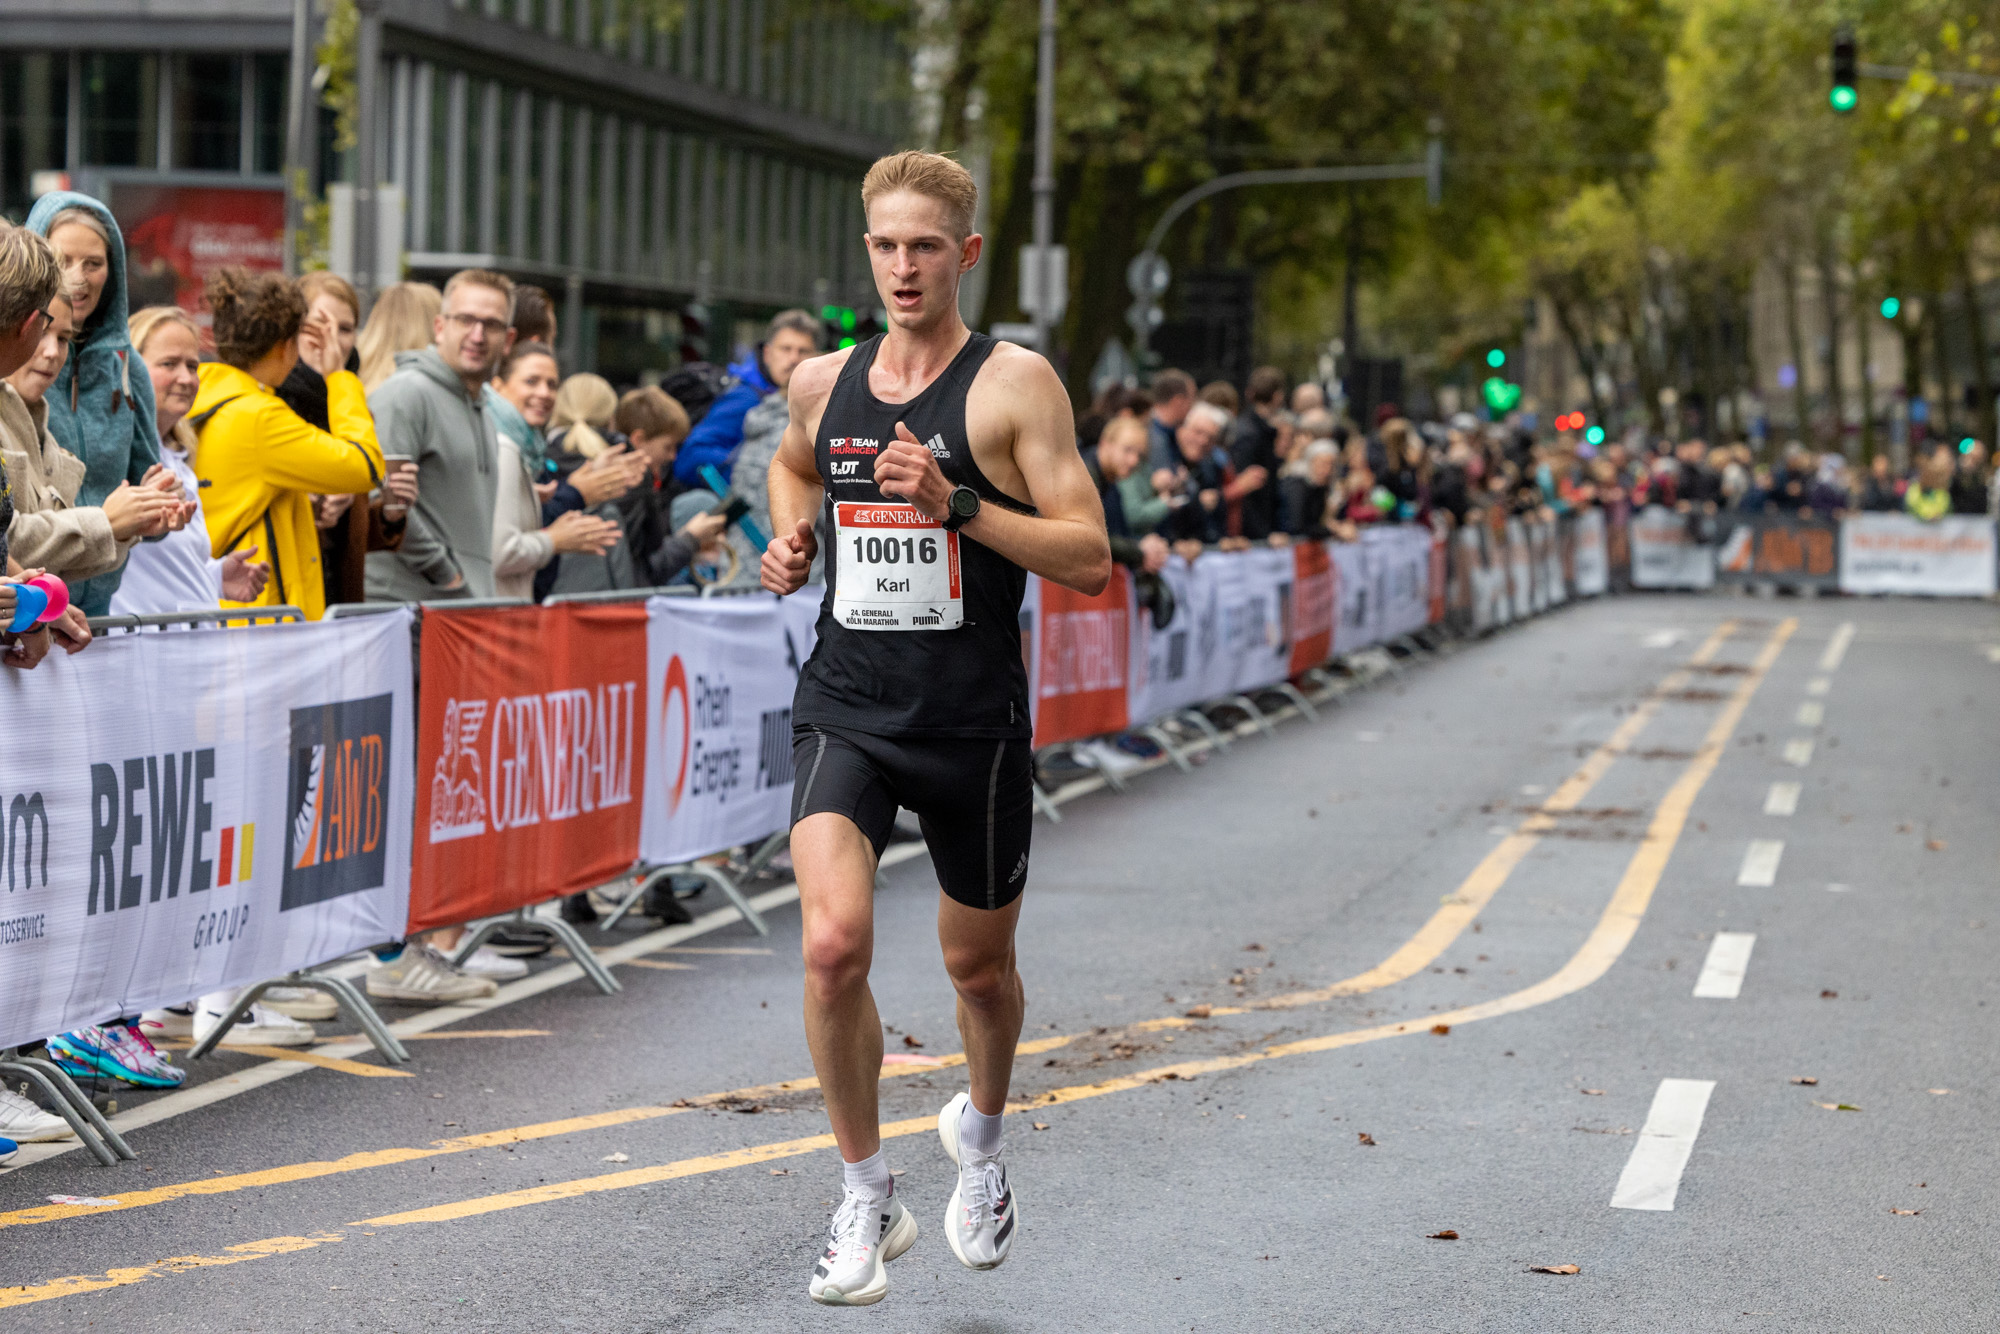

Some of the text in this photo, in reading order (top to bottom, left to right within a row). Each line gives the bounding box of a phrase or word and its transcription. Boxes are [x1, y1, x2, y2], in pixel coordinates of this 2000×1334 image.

[829, 438, 879, 448] TOP TEAM
[829, 446, 878, 455] THÜRINGEN
[931, 448, 951, 459] das
[830, 461, 860, 475] B&DT
[853, 536, 937, 564] 10016
[876, 578, 910, 593] Karl
[846, 616, 899, 626] KÖLN MARATHON
[850, 609, 893, 618] 24. GENERALI
[912, 616, 940, 626] PUMA
[694, 672, 732, 730] Rhein
[489, 681, 637, 832] GENERALI
[691, 735, 741, 803] Energie
[323, 734, 383, 863] AWB
[87, 747, 215, 916] REWE
[193, 903, 250, 950] GROUP
